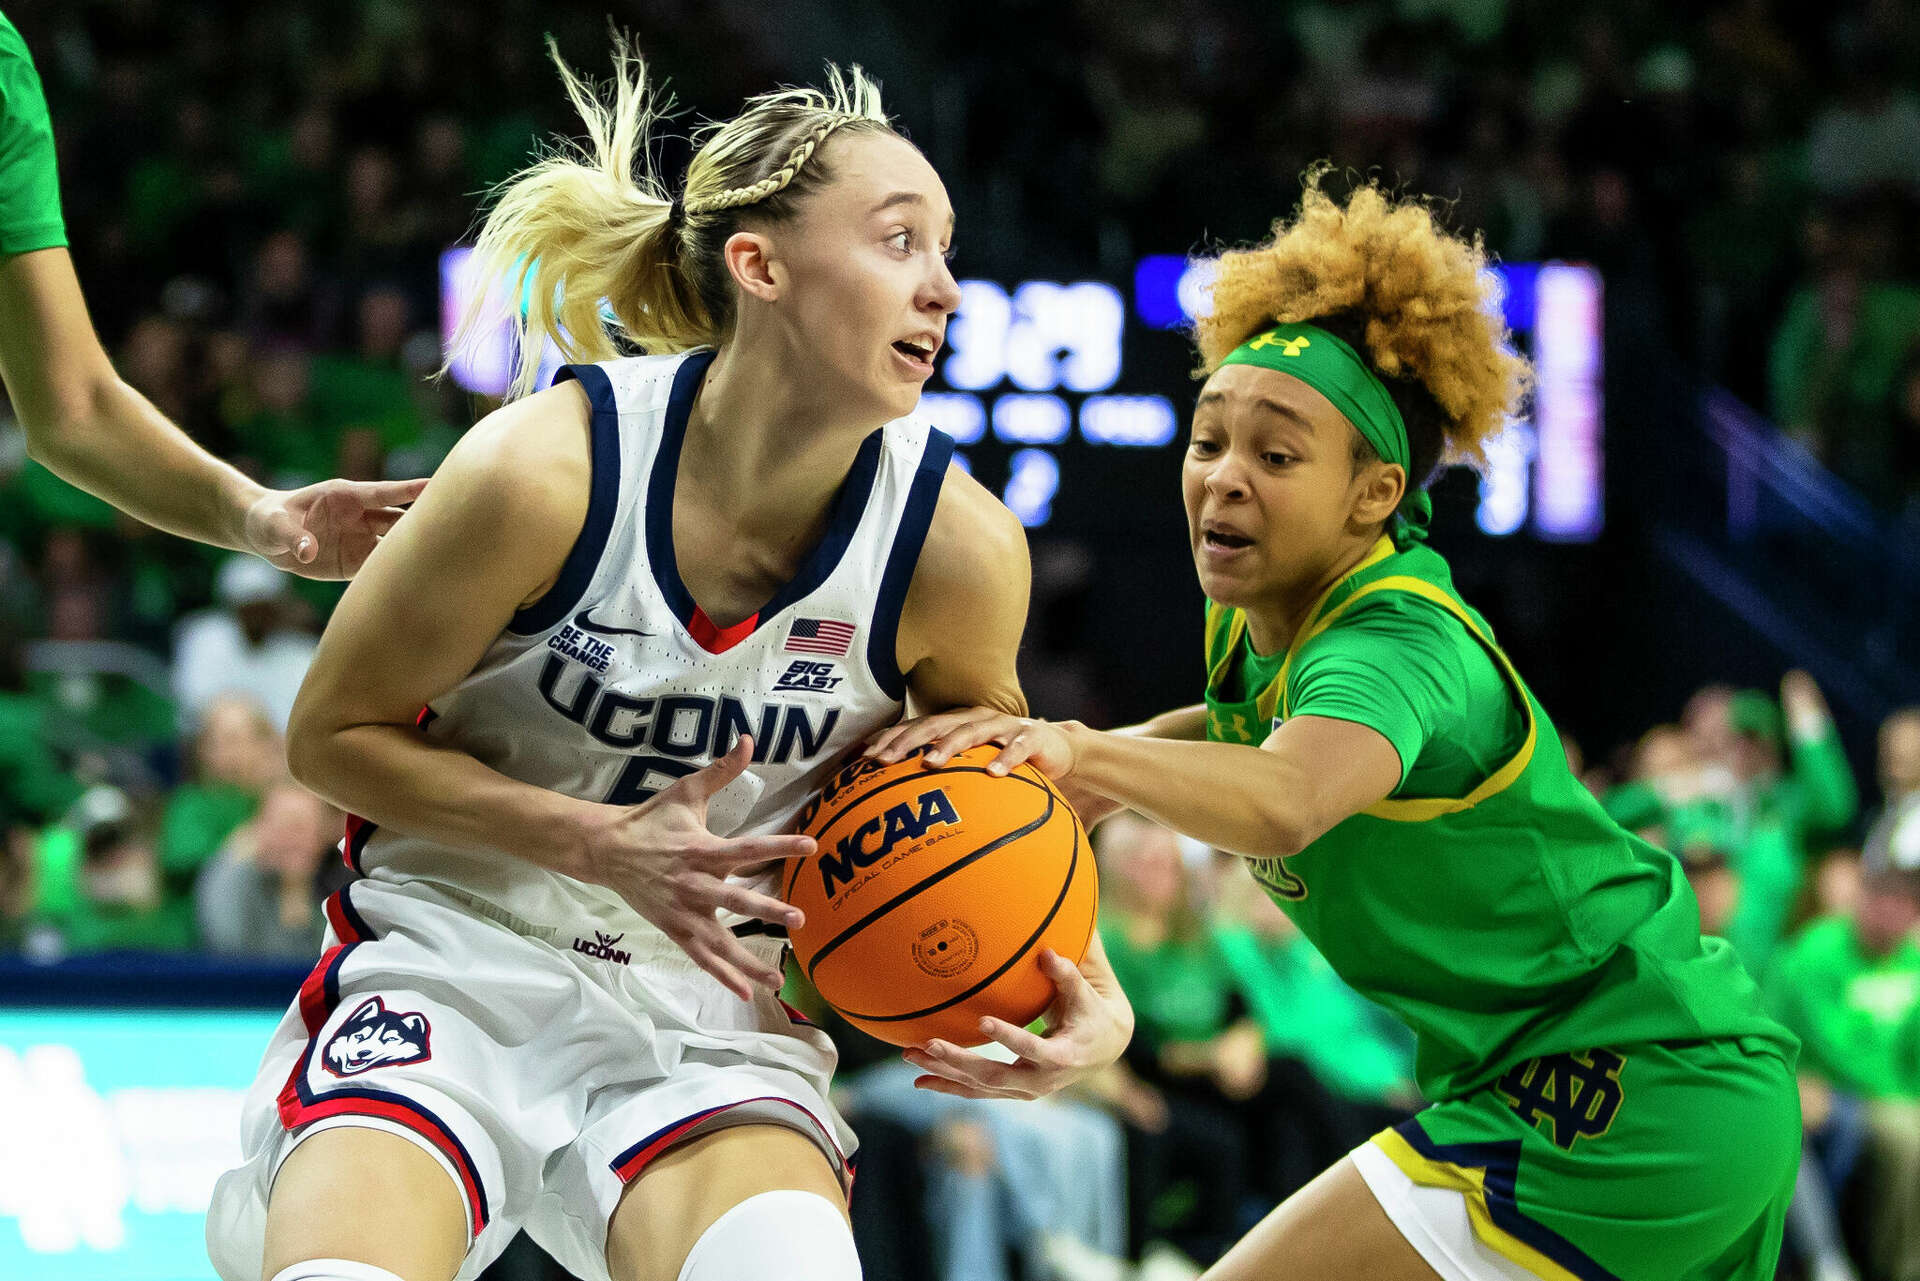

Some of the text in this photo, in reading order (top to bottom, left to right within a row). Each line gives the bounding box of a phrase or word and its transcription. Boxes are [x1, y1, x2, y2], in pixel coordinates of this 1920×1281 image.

[547, 635, 610, 673] CHANGE
[559, 624, 615, 660] BE THE
[777, 672, 843, 689] EAST
[786, 660, 835, 676] BIG
[537, 653, 842, 766] UCONN
[818, 788, 962, 900] NCAA
[882, 843, 923, 870] GAME
[924, 828, 965, 847] BALL
[572, 937, 632, 966] UCONN
